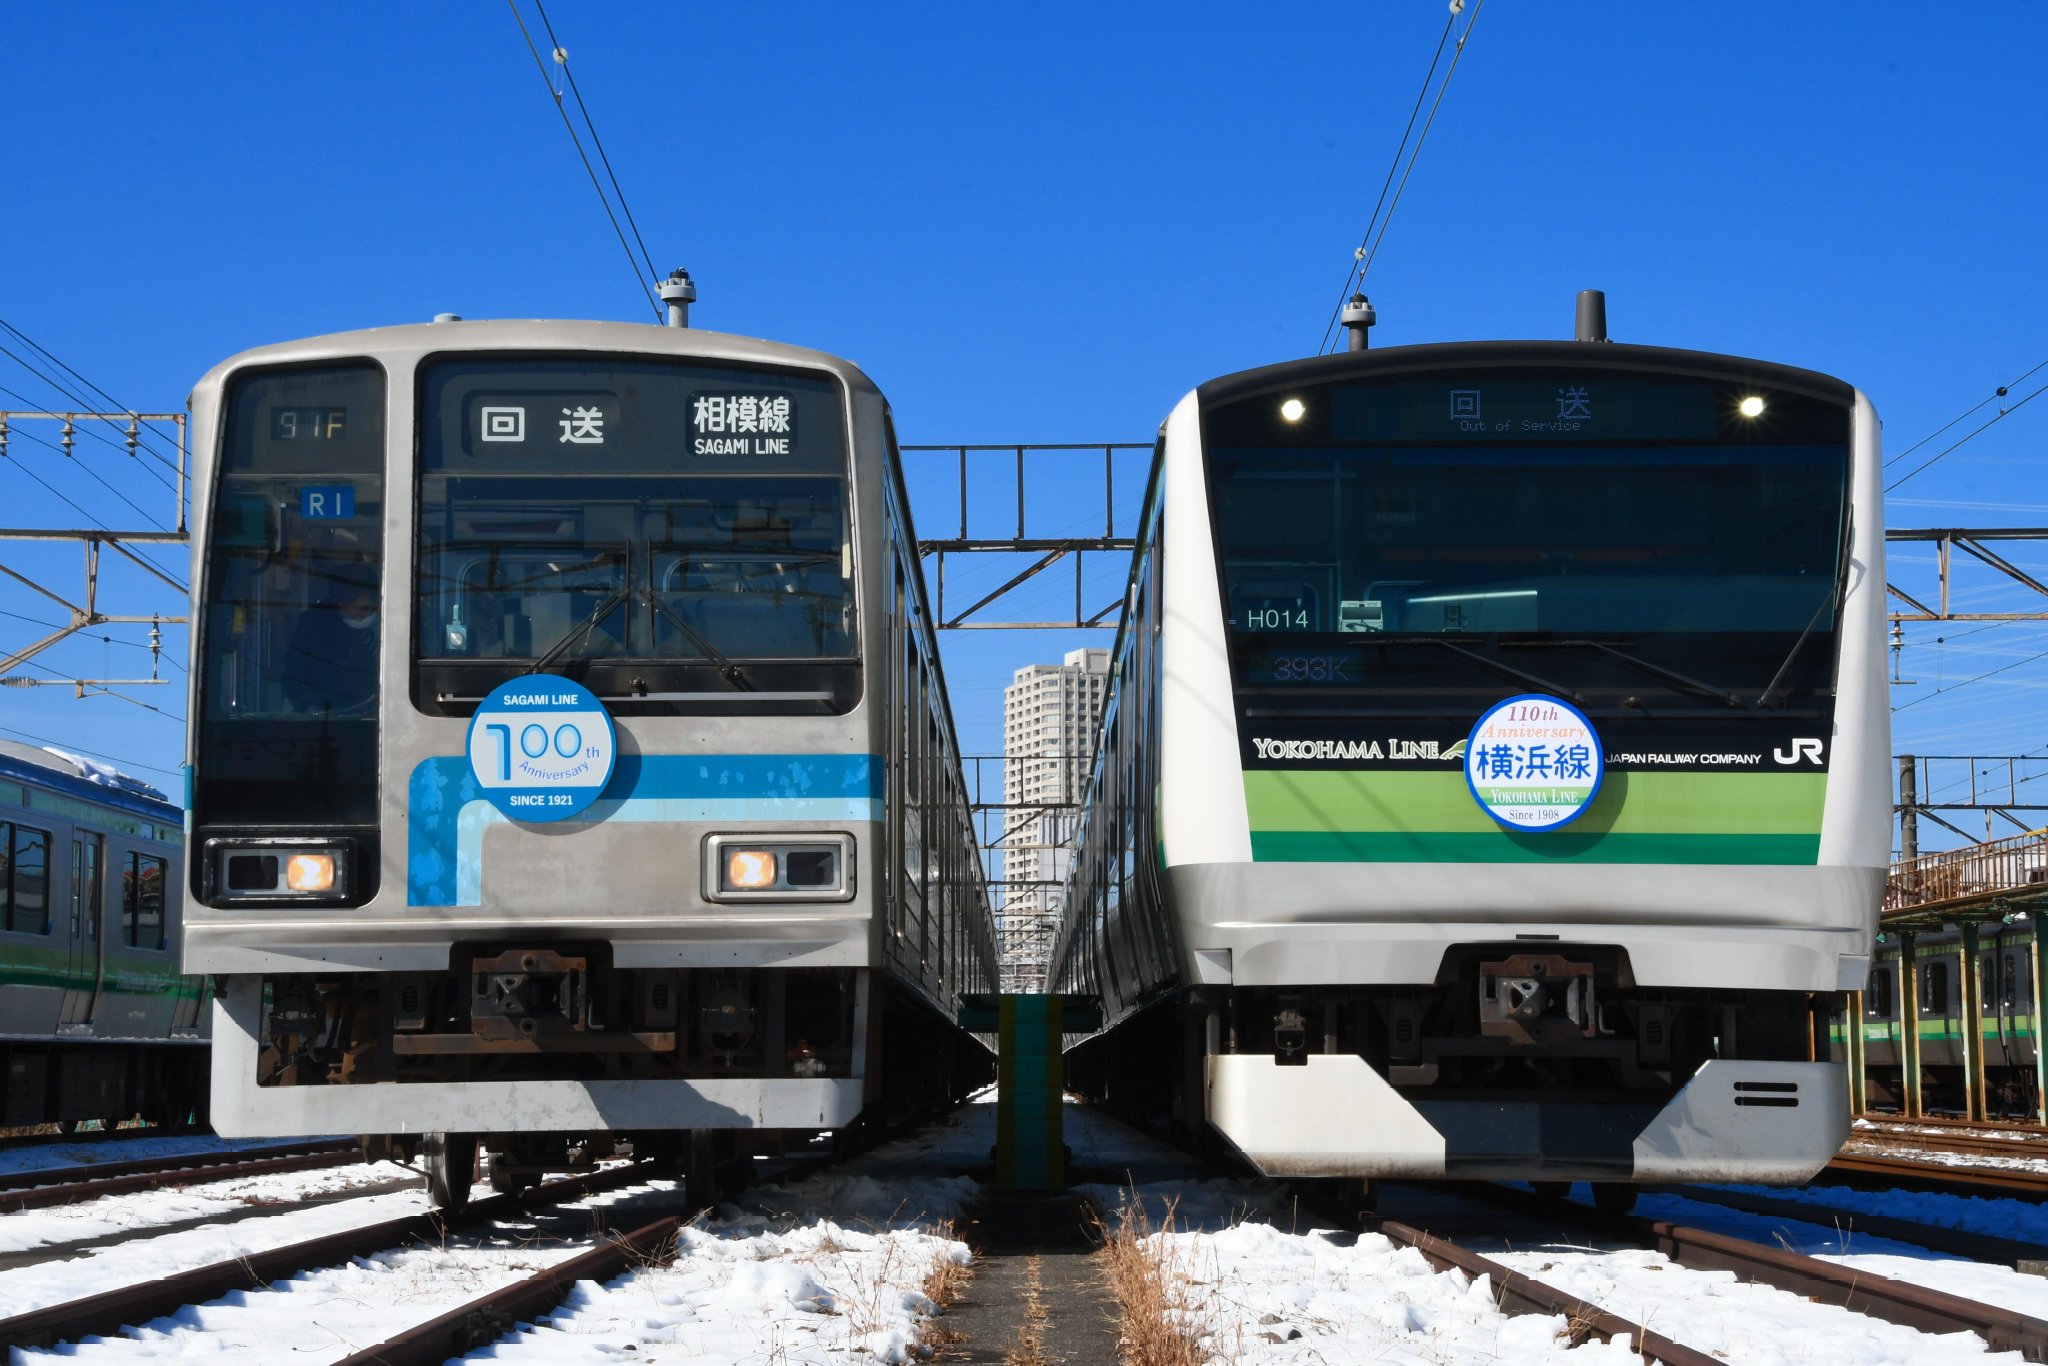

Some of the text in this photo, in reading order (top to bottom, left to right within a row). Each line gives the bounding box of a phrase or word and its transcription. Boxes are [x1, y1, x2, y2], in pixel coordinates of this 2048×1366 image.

[694, 396, 790, 433] 相模線
[281, 412, 345, 439] 91F
[1460, 420, 1581, 432] Out of Service
[694, 438, 790, 455] SAGAMI LINE
[1248, 609, 1309, 629] H014
[1274, 656, 1349, 681] 393K
[503, 694, 579, 705] SAGAMI LINE
[1508, 706, 1559, 721] 110th
[1480, 723, 1587, 743] Anniversary
[1253, 738, 1439, 760] YOKOHAMA LINE
[1605, 753, 1762, 764] JAPAN RAILWAY COMPANY
[1773, 738, 1824, 765] JR
[518, 760, 590, 781] Anniversary
[1476, 743, 1592, 780] 横浜線
[510, 795, 573, 806] SINCE 1921
[1491, 788, 1578, 804] YOKOHAMA LINE
[1509, 809, 1560, 820] Since 1908
